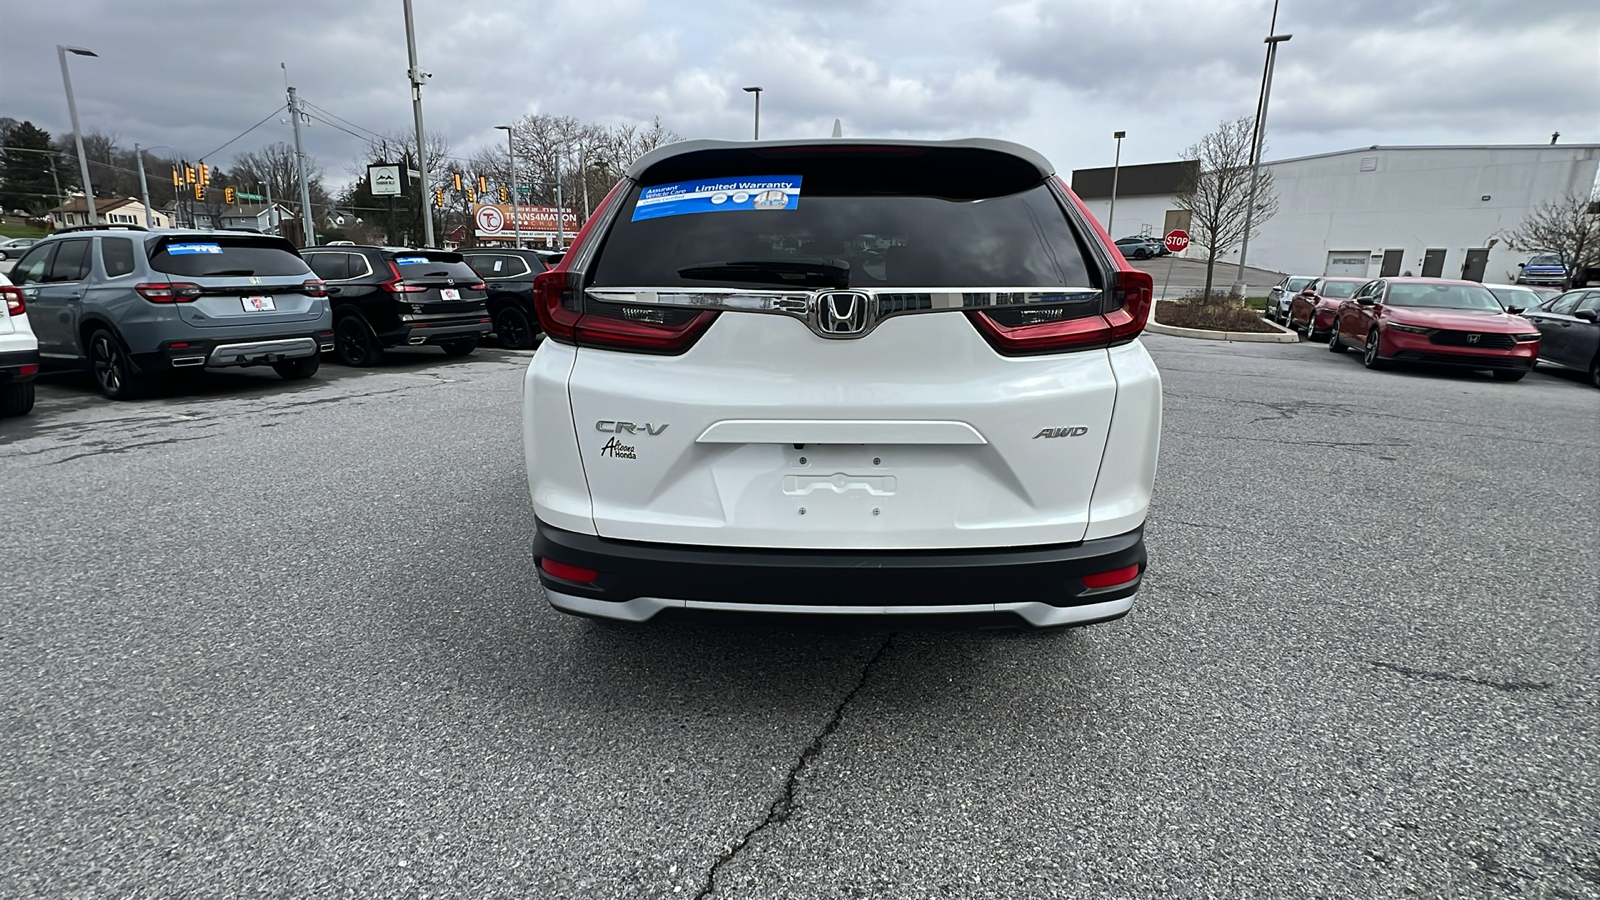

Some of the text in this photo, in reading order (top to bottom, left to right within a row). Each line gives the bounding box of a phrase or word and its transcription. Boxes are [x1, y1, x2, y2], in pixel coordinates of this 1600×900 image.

[647, 185, 678, 194] Assurant
[695, 182, 793, 193] Limited Warranty
[645, 191, 670, 199] Vehicle
[505, 212, 577, 222] TRANS4MATON
[1166, 235, 1189, 247] STOP
[595, 420, 671, 436] CR-V
[1031, 425, 1089, 440] AWD
[601, 436, 635, 458] Altoona
[615, 451, 637, 460] Honda
